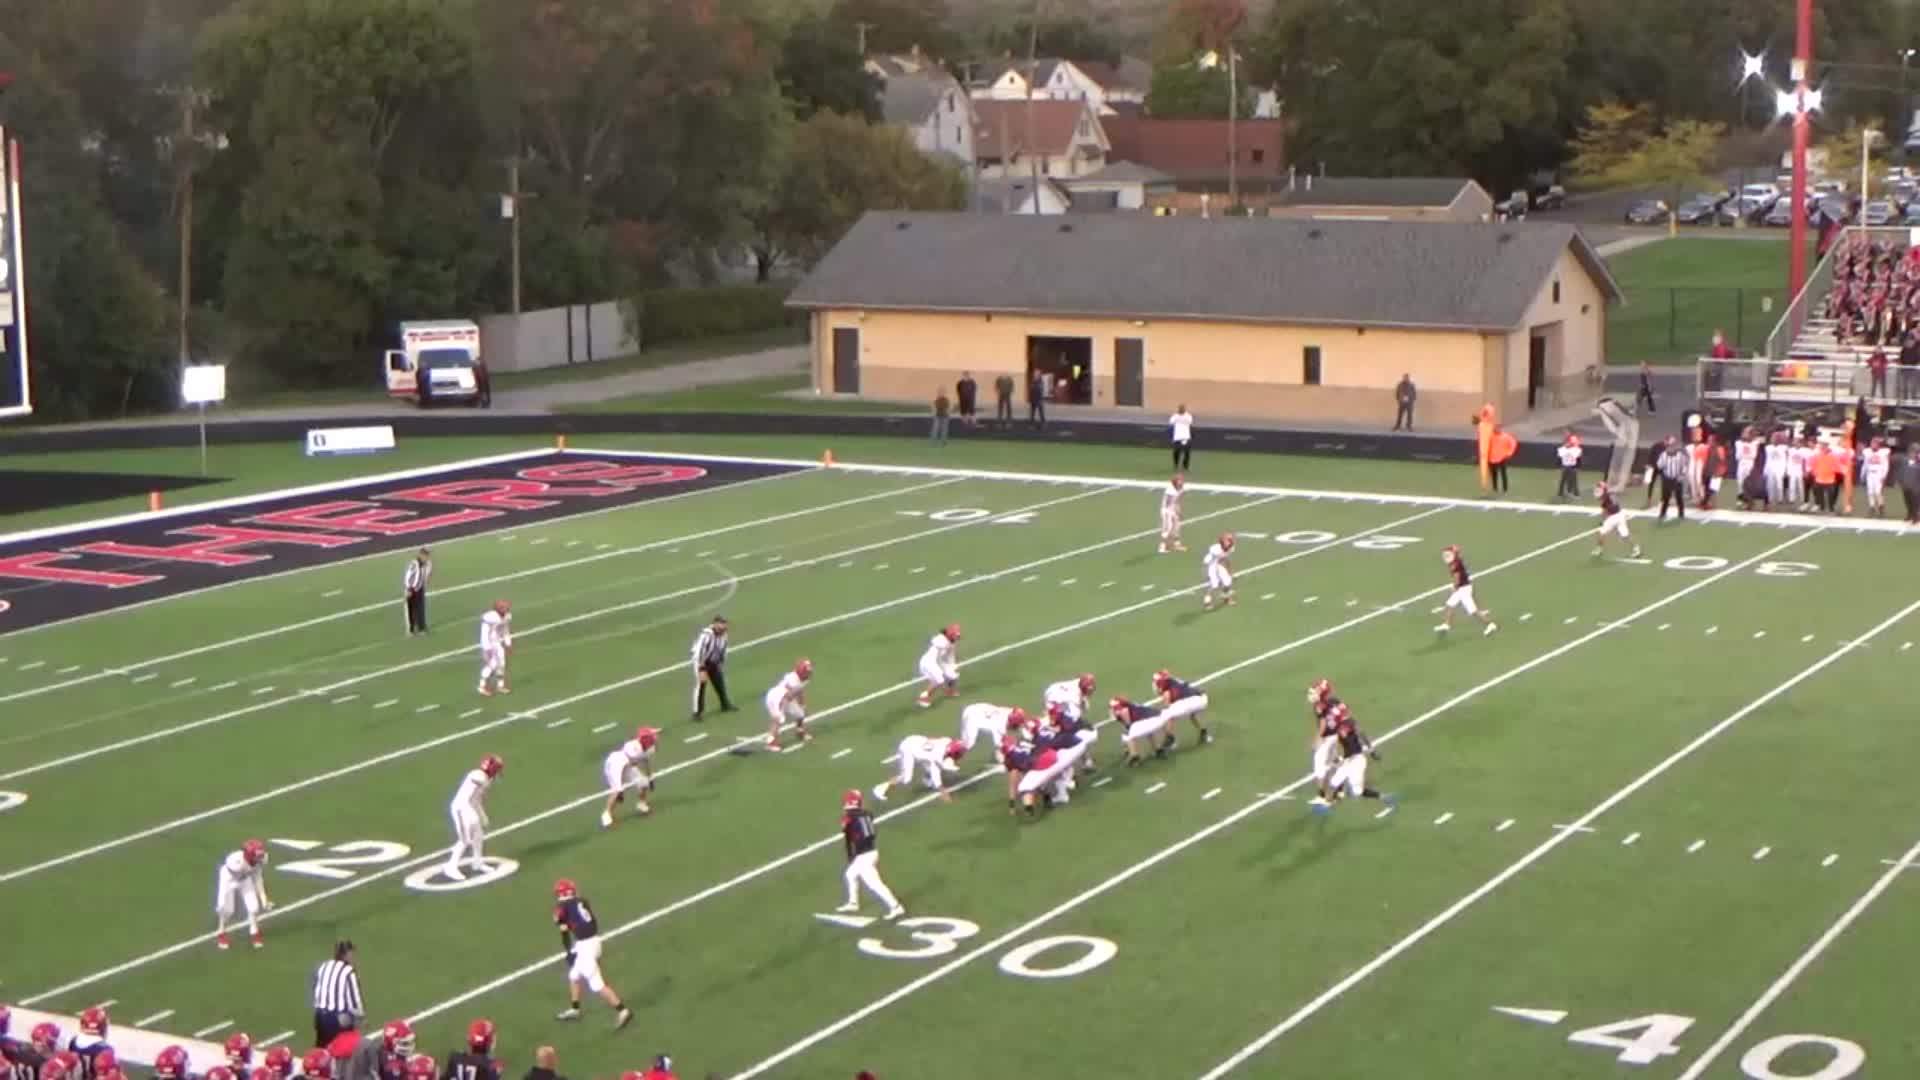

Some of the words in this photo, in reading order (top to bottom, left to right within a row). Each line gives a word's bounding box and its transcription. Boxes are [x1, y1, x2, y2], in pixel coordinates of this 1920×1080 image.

[0, 461, 708, 611] THERS
[275, 840, 520, 891] 20
[858, 917, 1118, 977] 30
[1568, 1013, 1867, 1080] 40
